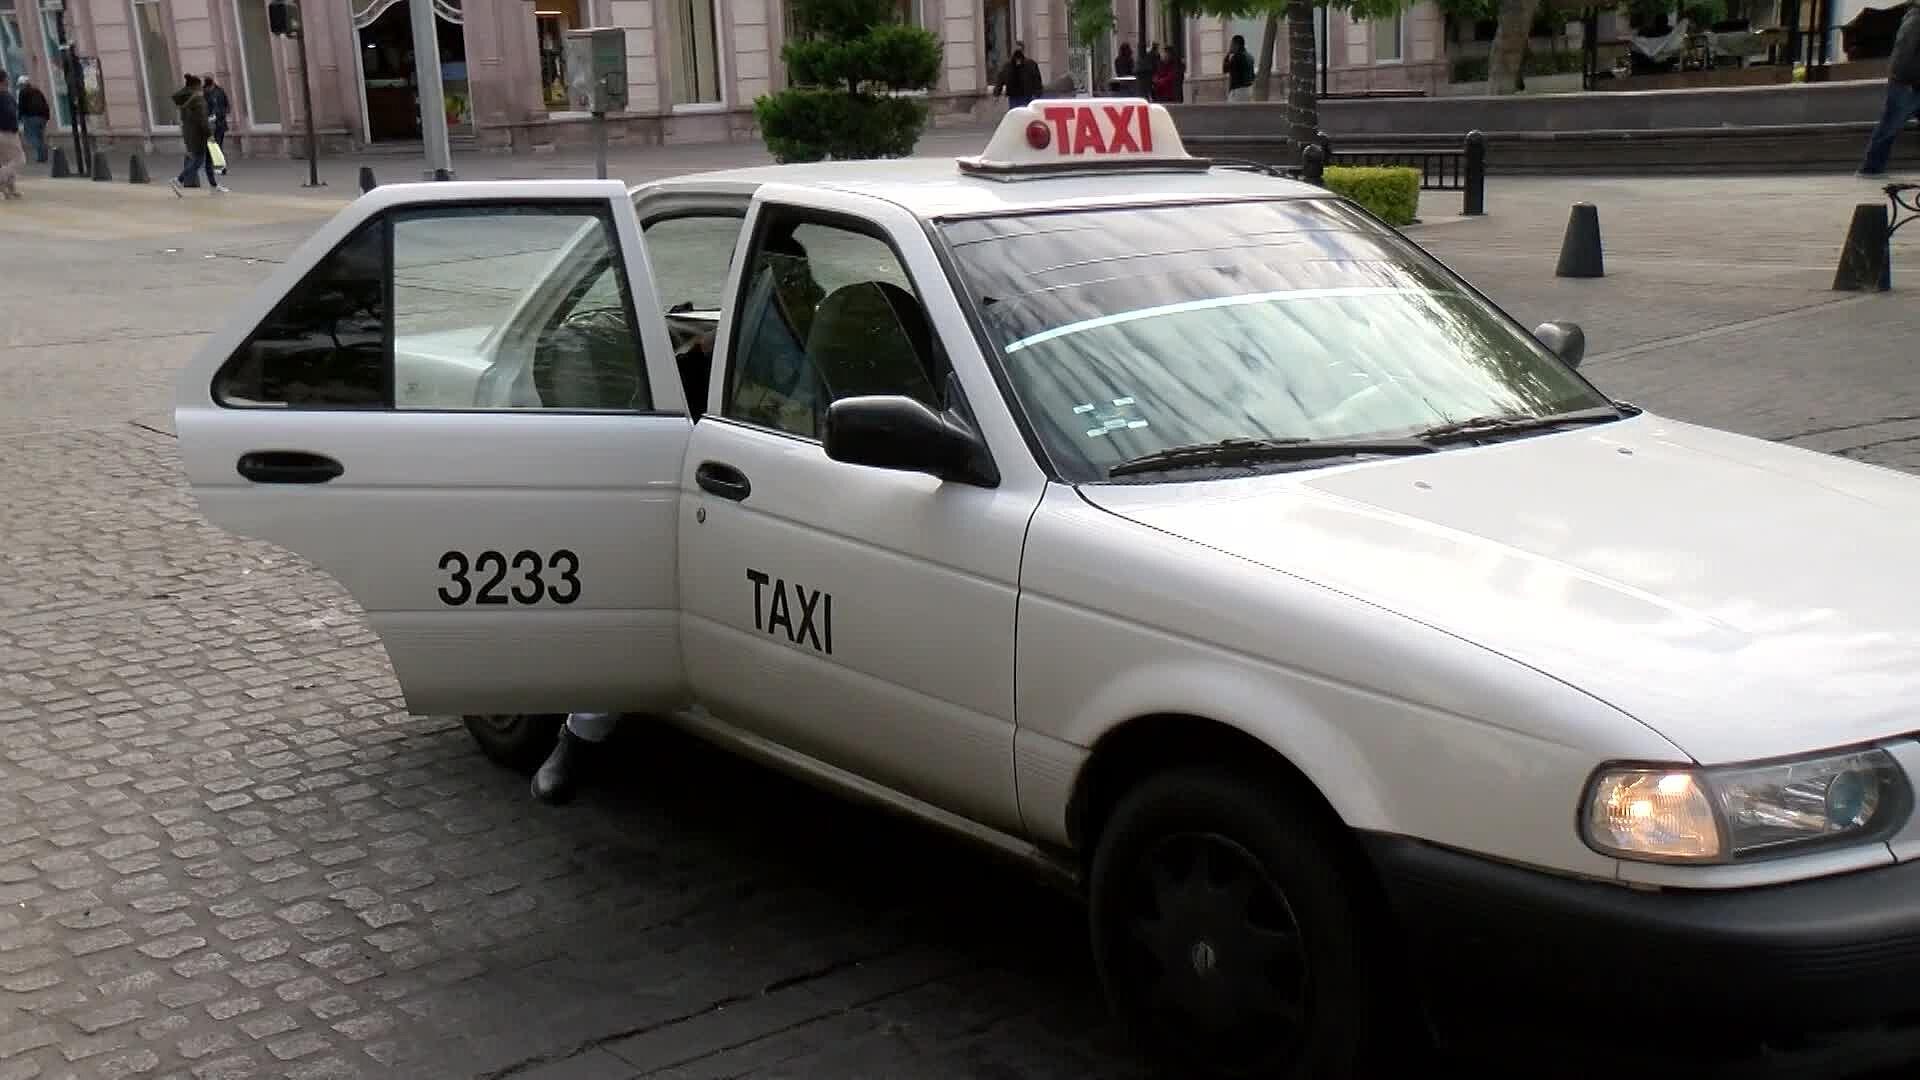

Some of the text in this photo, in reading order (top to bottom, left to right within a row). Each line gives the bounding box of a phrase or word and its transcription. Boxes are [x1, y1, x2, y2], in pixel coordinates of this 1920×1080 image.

[1044, 105, 1153, 155] TAXI
[438, 549, 581, 606] 3233
[746, 568, 832, 655] TAXI
